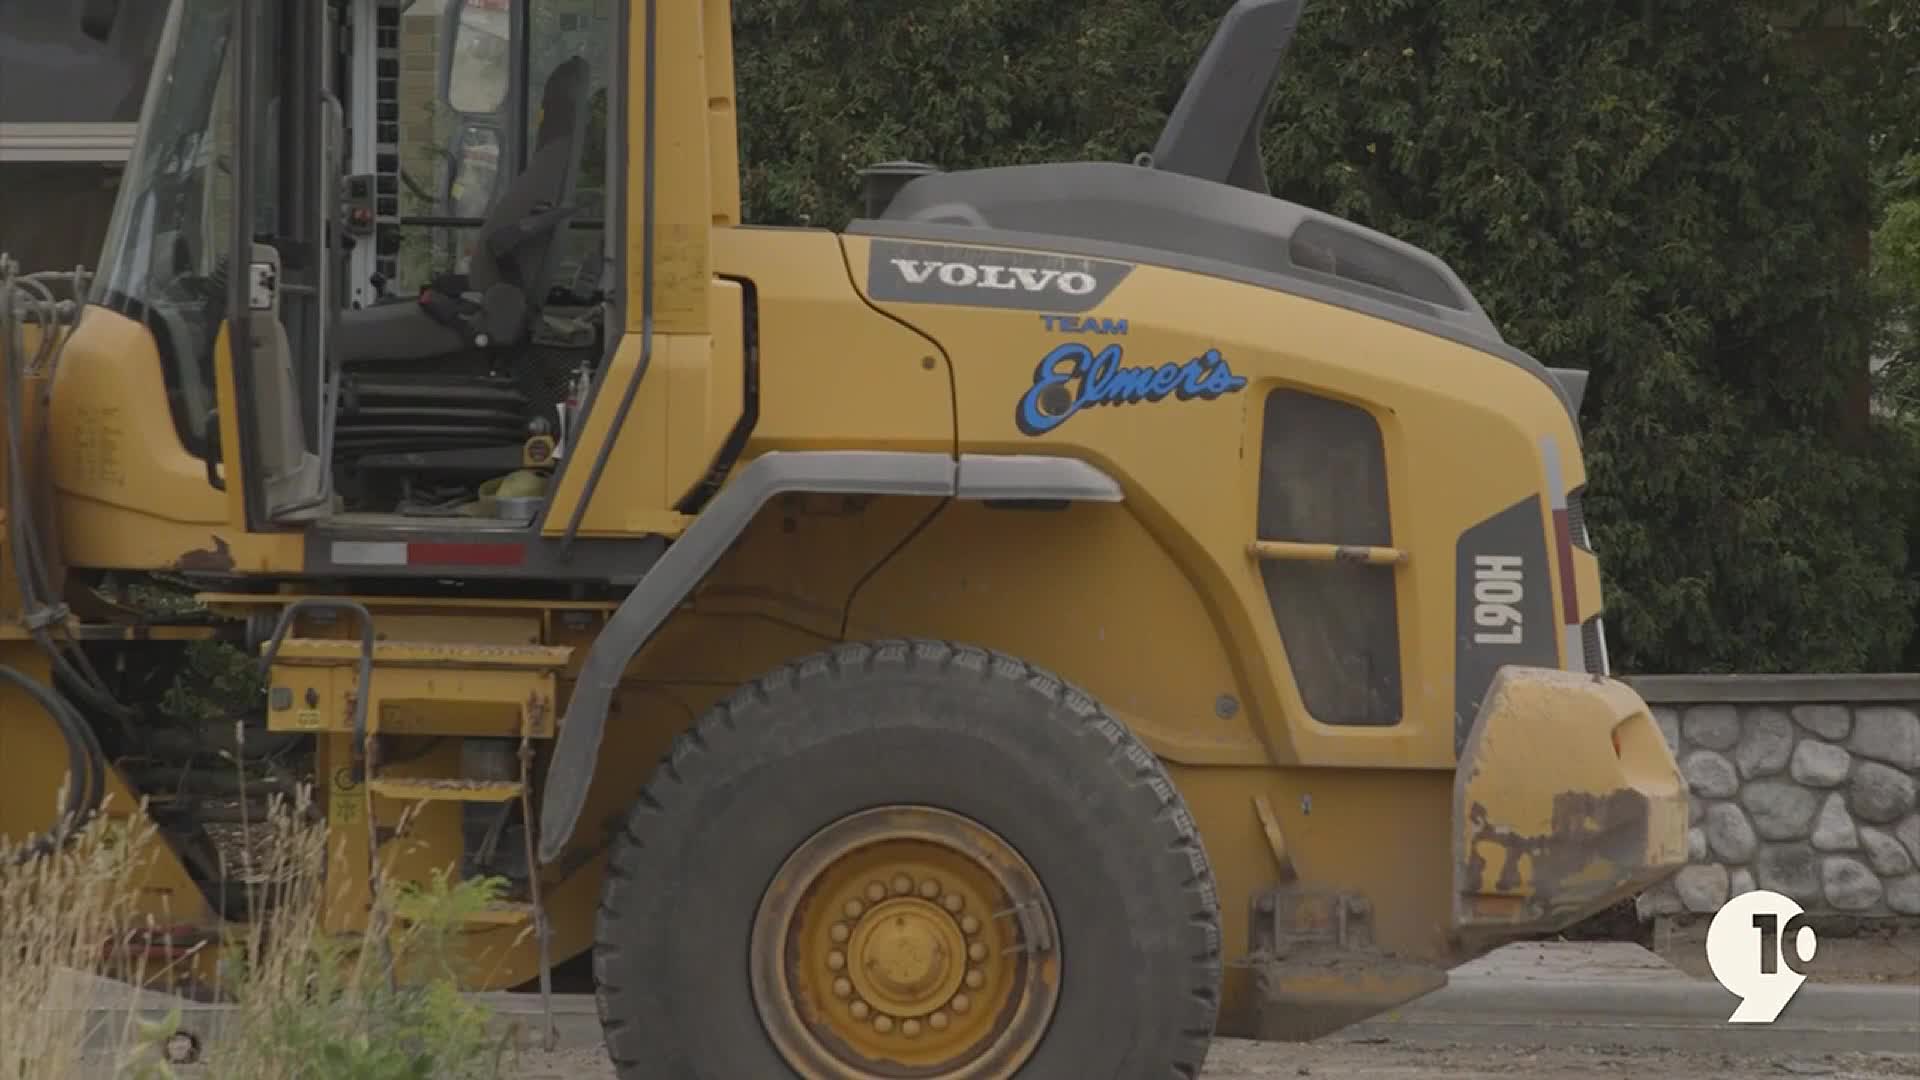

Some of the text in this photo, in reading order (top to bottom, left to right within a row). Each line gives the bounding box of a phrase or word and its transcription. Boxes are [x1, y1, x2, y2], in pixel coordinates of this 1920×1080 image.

[889, 258, 1097, 296] VOLVO
[1040, 314, 1129, 335] TEAM
[1015, 342, 1248, 437] Elmer's
[1474, 555, 1523, 644] L90H
